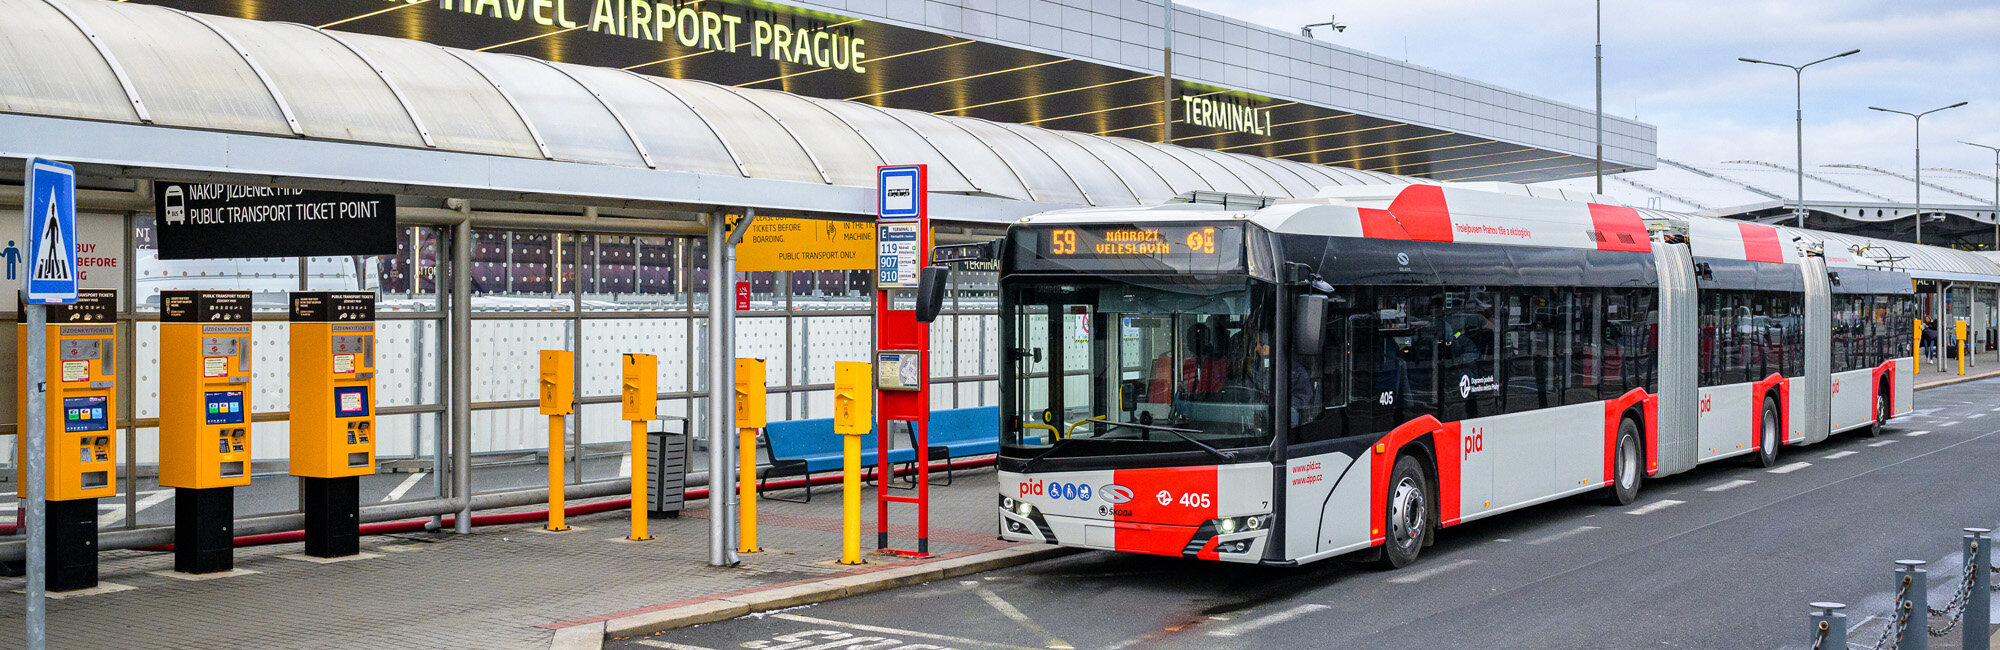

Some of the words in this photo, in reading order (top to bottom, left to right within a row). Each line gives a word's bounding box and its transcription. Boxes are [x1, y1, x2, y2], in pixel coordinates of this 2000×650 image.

[591, 0, 741, 53] AIRPORT
[753, 19, 865, 74] PRAGUE
[1182, 95, 1263, 136] TERMINAL
[1265, 110, 1271, 137] 1
[190, 208, 225, 224] PUBLIC
[226, 204, 292, 223] TRANSPORT
[296, 202, 336, 220] TICKET
[340, 200, 380, 219] POINT
[752, 224, 777, 232] TICKETS
[778, 223, 802, 232] BEFORE
[882, 229, 887, 239] E
[1106, 228, 1159, 242] NÁDRAŽÍ
[1053, 229, 1076, 255] 59
[1096, 241, 1170, 254] VELESLAVÍN
[881, 243, 898, 254] 119
[778, 252, 800, 260] PUBLIC
[802, 251, 839, 260] TRANSPORT
[840, 250, 856, 259] ONLY
[78, 258, 116, 268] BEFORE
[880, 256, 898, 268] 907
[880, 270, 898, 282] 910
[1380, 391, 1393, 405] 405
[1700, 393, 1711, 418] pid
[1464, 427, 1483, 460] pid
[1292, 461, 1321, 473] www.pid.cz
[1292, 474, 1322, 485] www.dpp.cz
[1020, 478, 1043, 498] pid
[1179, 492, 1210, 508] 405
[1262, 501, 1268, 509] 7
[1109, 507, 1133, 517] ŠKODA
